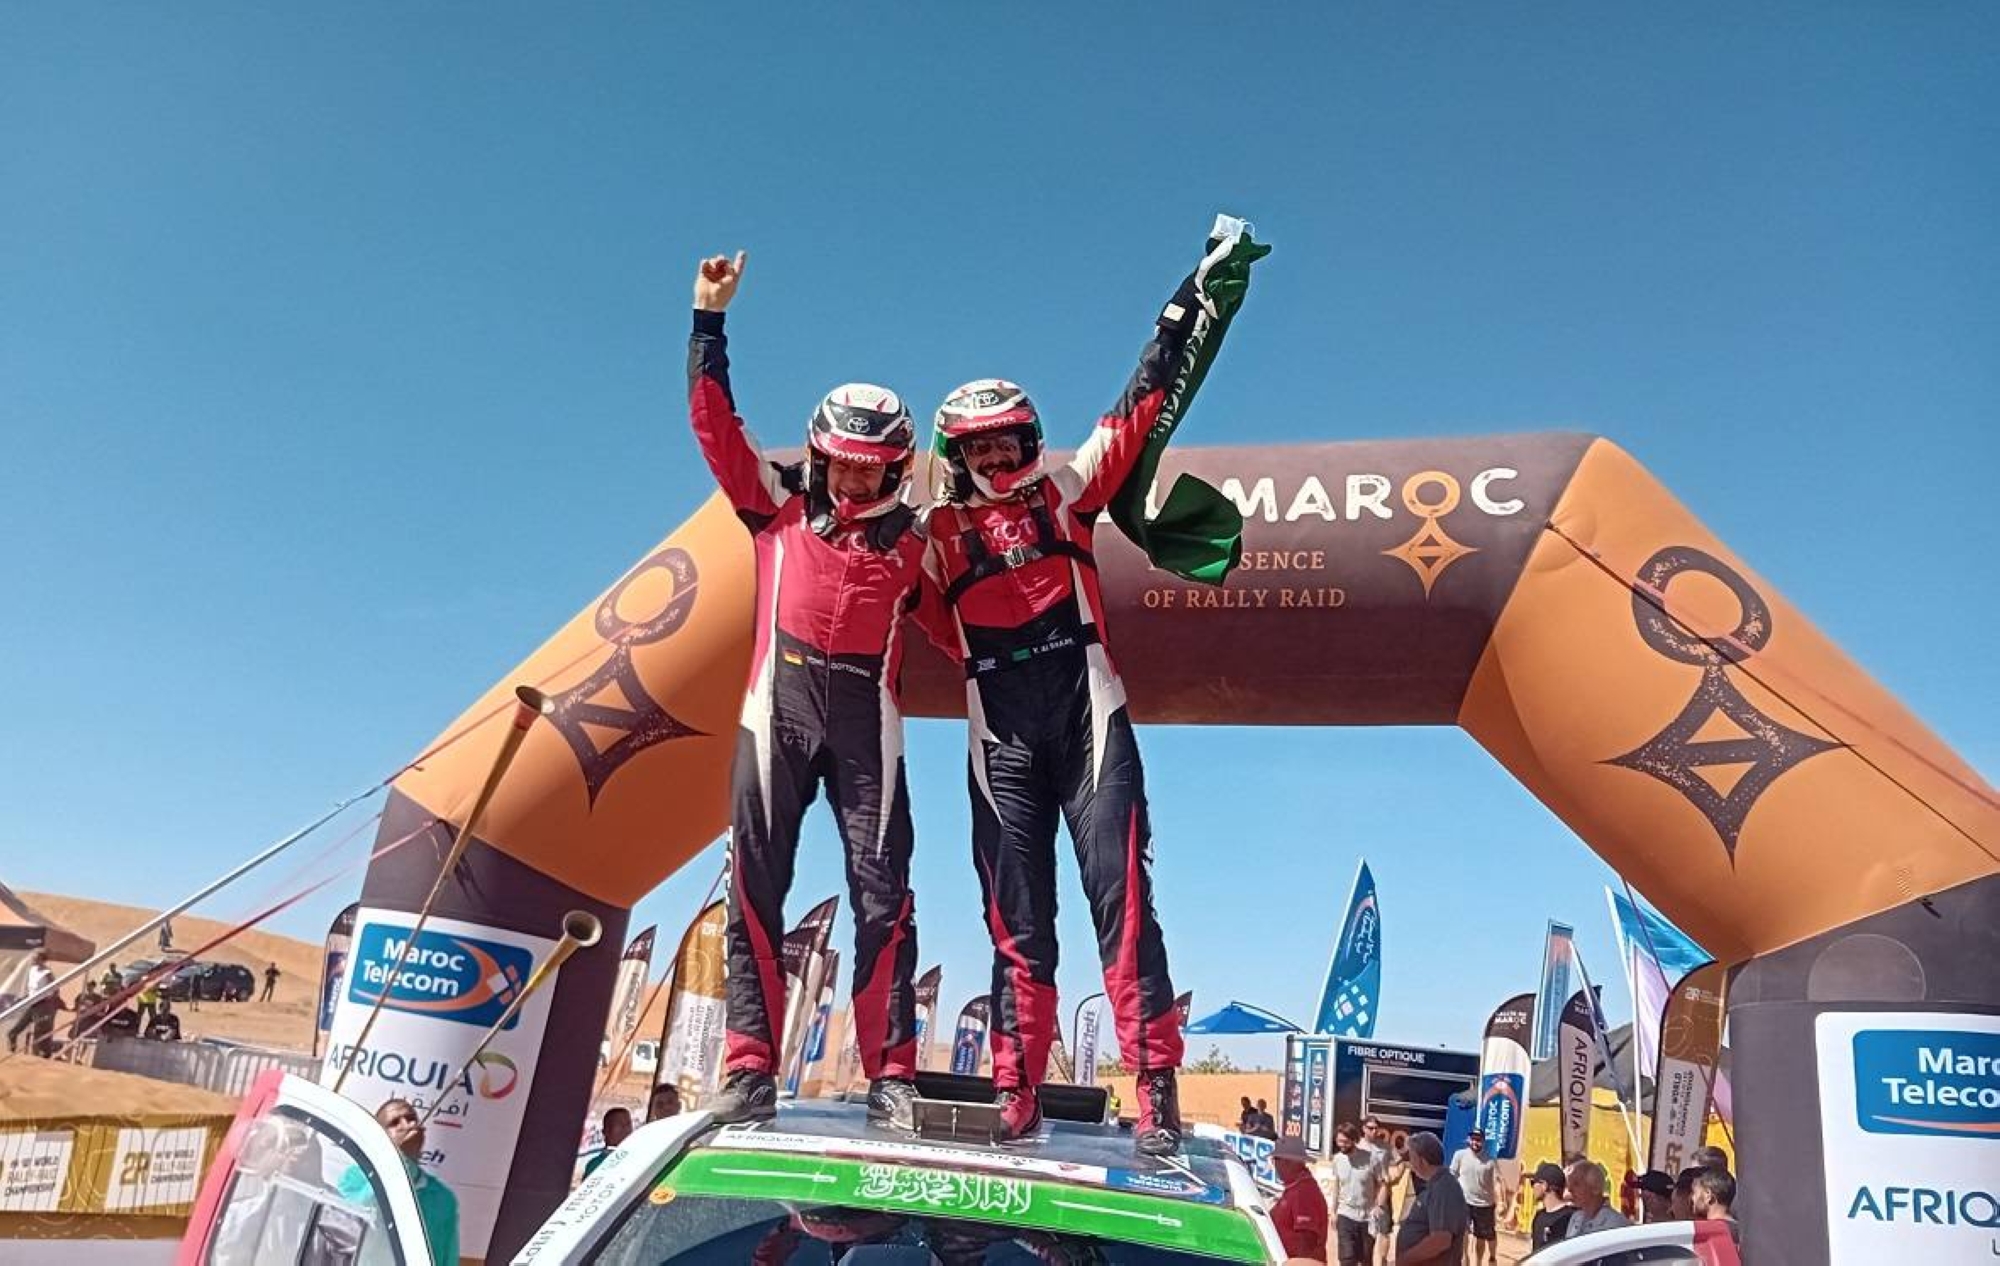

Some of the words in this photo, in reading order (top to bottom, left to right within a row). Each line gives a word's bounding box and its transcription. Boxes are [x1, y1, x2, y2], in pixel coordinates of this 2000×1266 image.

[1240, 550, 1326, 571] SENCE
[1143, 589, 1176, 609] OF
[1185, 588, 1271, 609] RALLY
[1280, 587, 1346, 609] RAID
[382, 937, 466, 972] Maroc
[362, 959, 460, 997] Telecom
[328, 1042, 474, 1096] AFRIQUIA
[1347, 1045, 1378, 1057] FIBRE
[1379, 1048, 1426, 1064] OPTIQUE
[1881, 1077, 2000, 1108] Teleco
[1485, 1100, 1498, 1141] Maroc
[1847, 1184, 2000, 1228] AFRIQ
